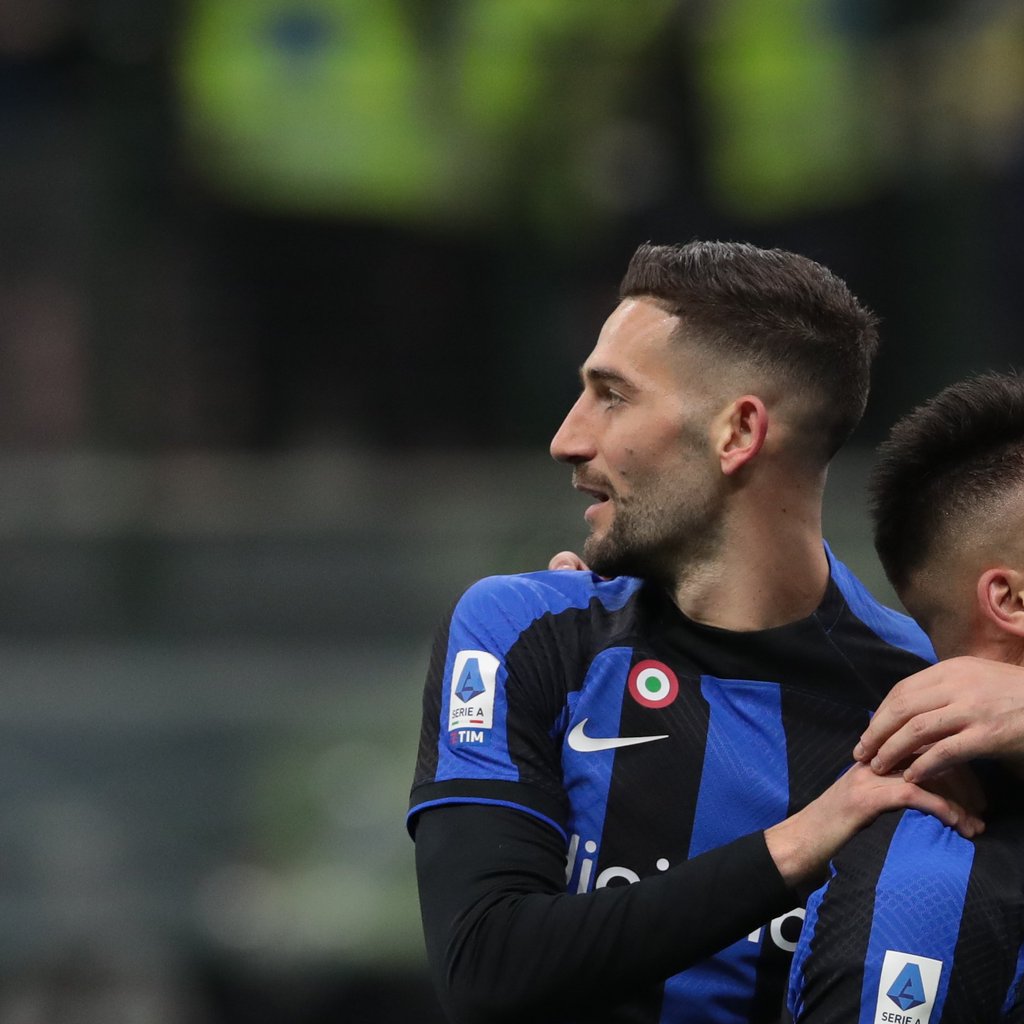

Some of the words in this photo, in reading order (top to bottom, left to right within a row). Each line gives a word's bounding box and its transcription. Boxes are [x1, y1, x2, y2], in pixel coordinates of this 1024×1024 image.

[452, 707, 474, 719] SERIE
[476, 707, 484, 717] A
[458, 730, 484, 743] TIM
